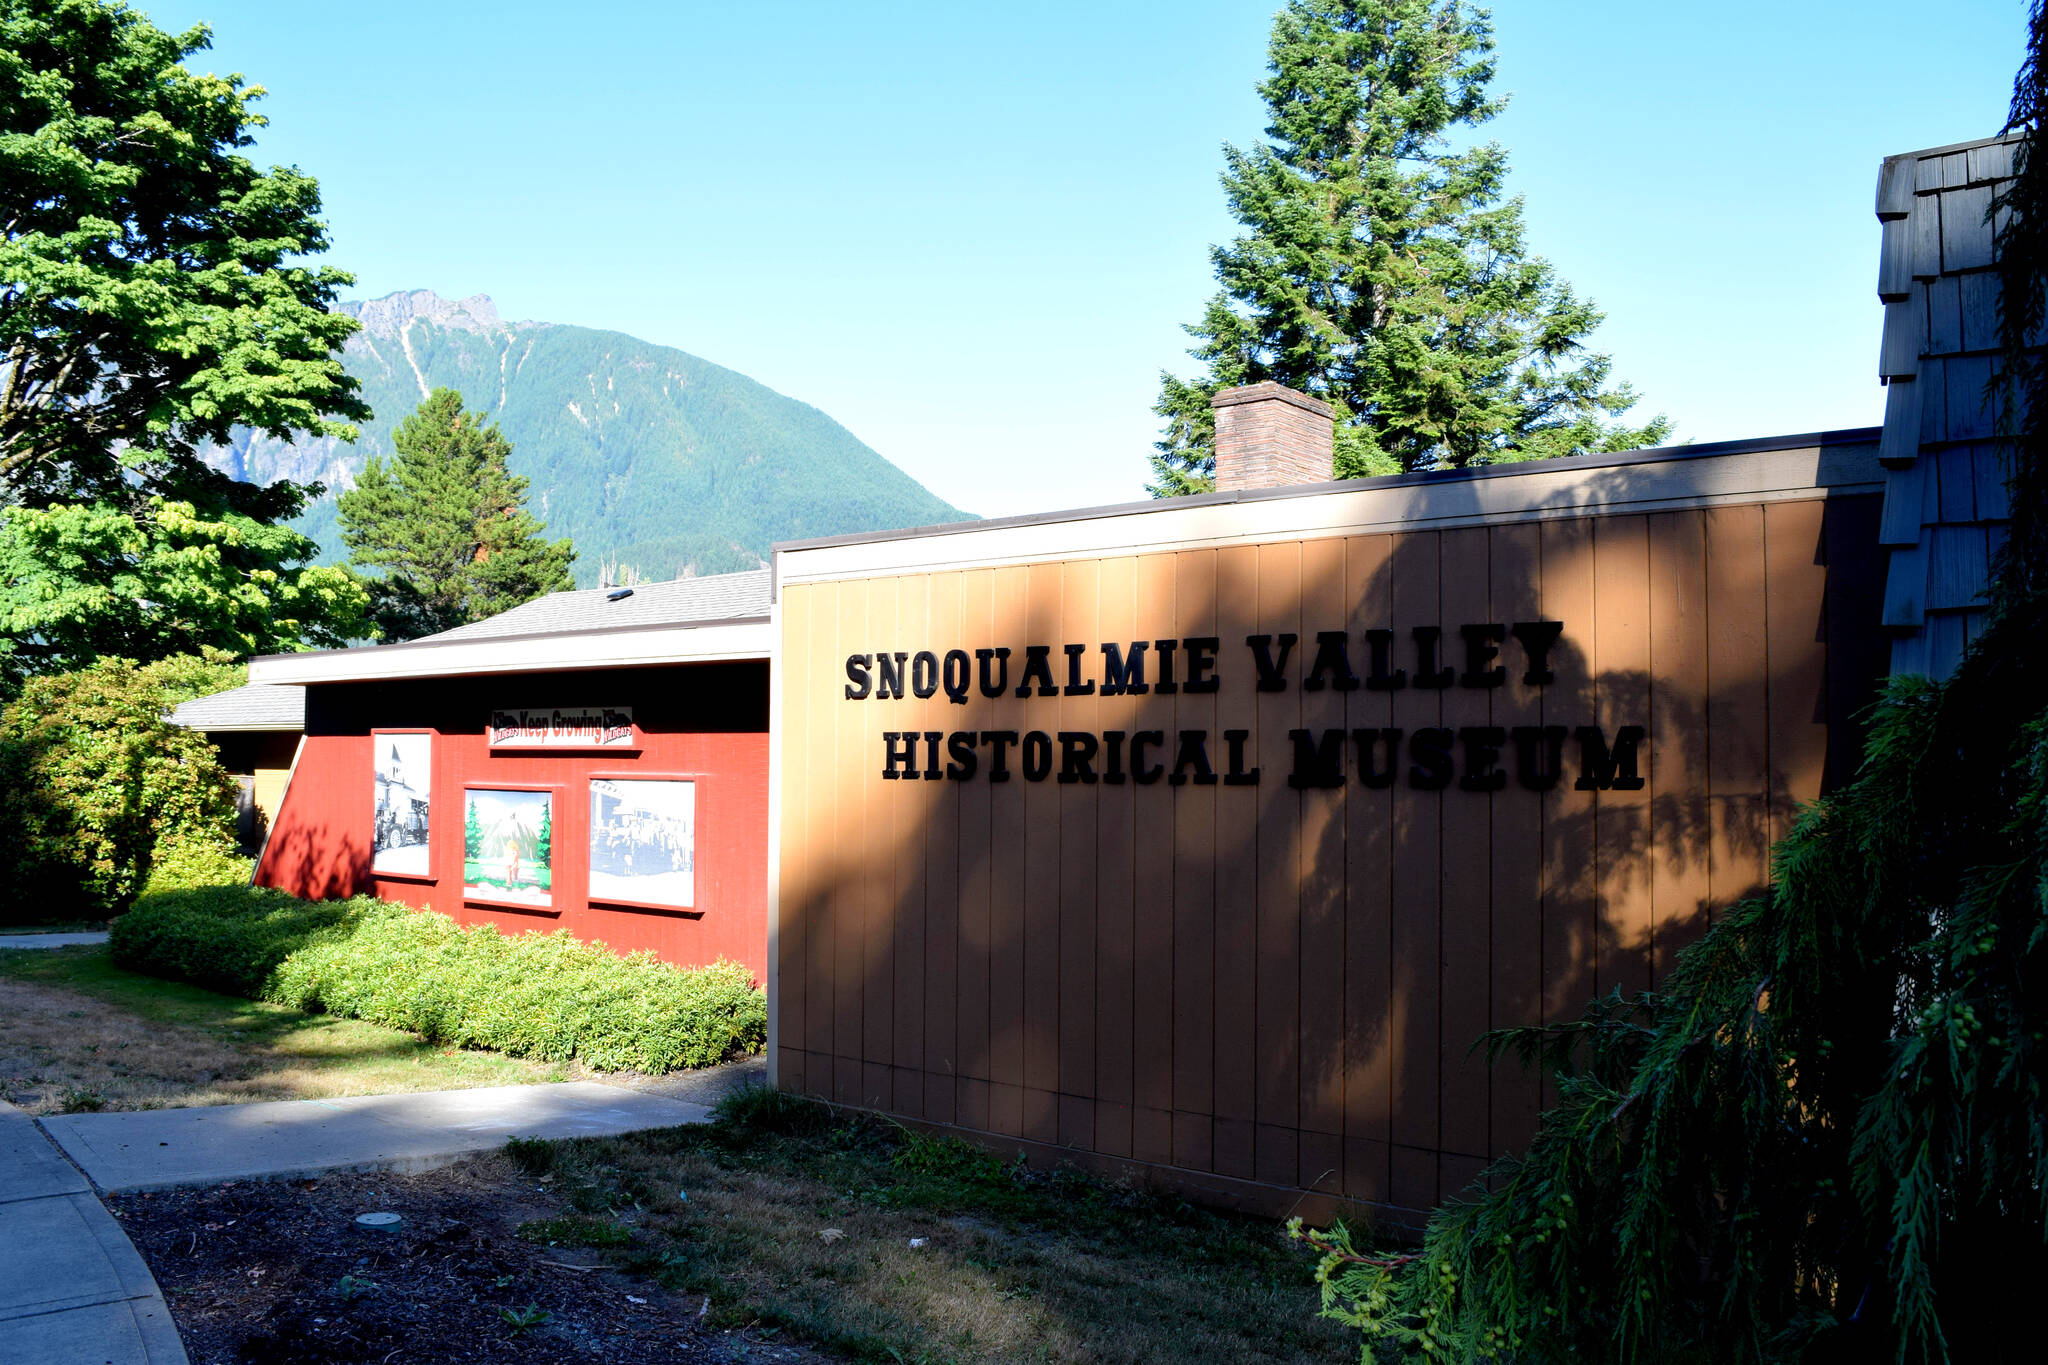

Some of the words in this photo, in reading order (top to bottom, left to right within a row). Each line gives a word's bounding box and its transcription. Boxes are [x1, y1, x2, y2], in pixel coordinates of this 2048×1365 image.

[845, 637, 1219, 705] SNOQUALMIE
[1246, 621, 1564, 692] VALLEY
[519, 710, 549, 744] Keep
[552, 709, 602, 744] Growing
[882, 729, 1260, 786] HISTORICAL
[1288, 725, 1645, 790] MUSEUM
